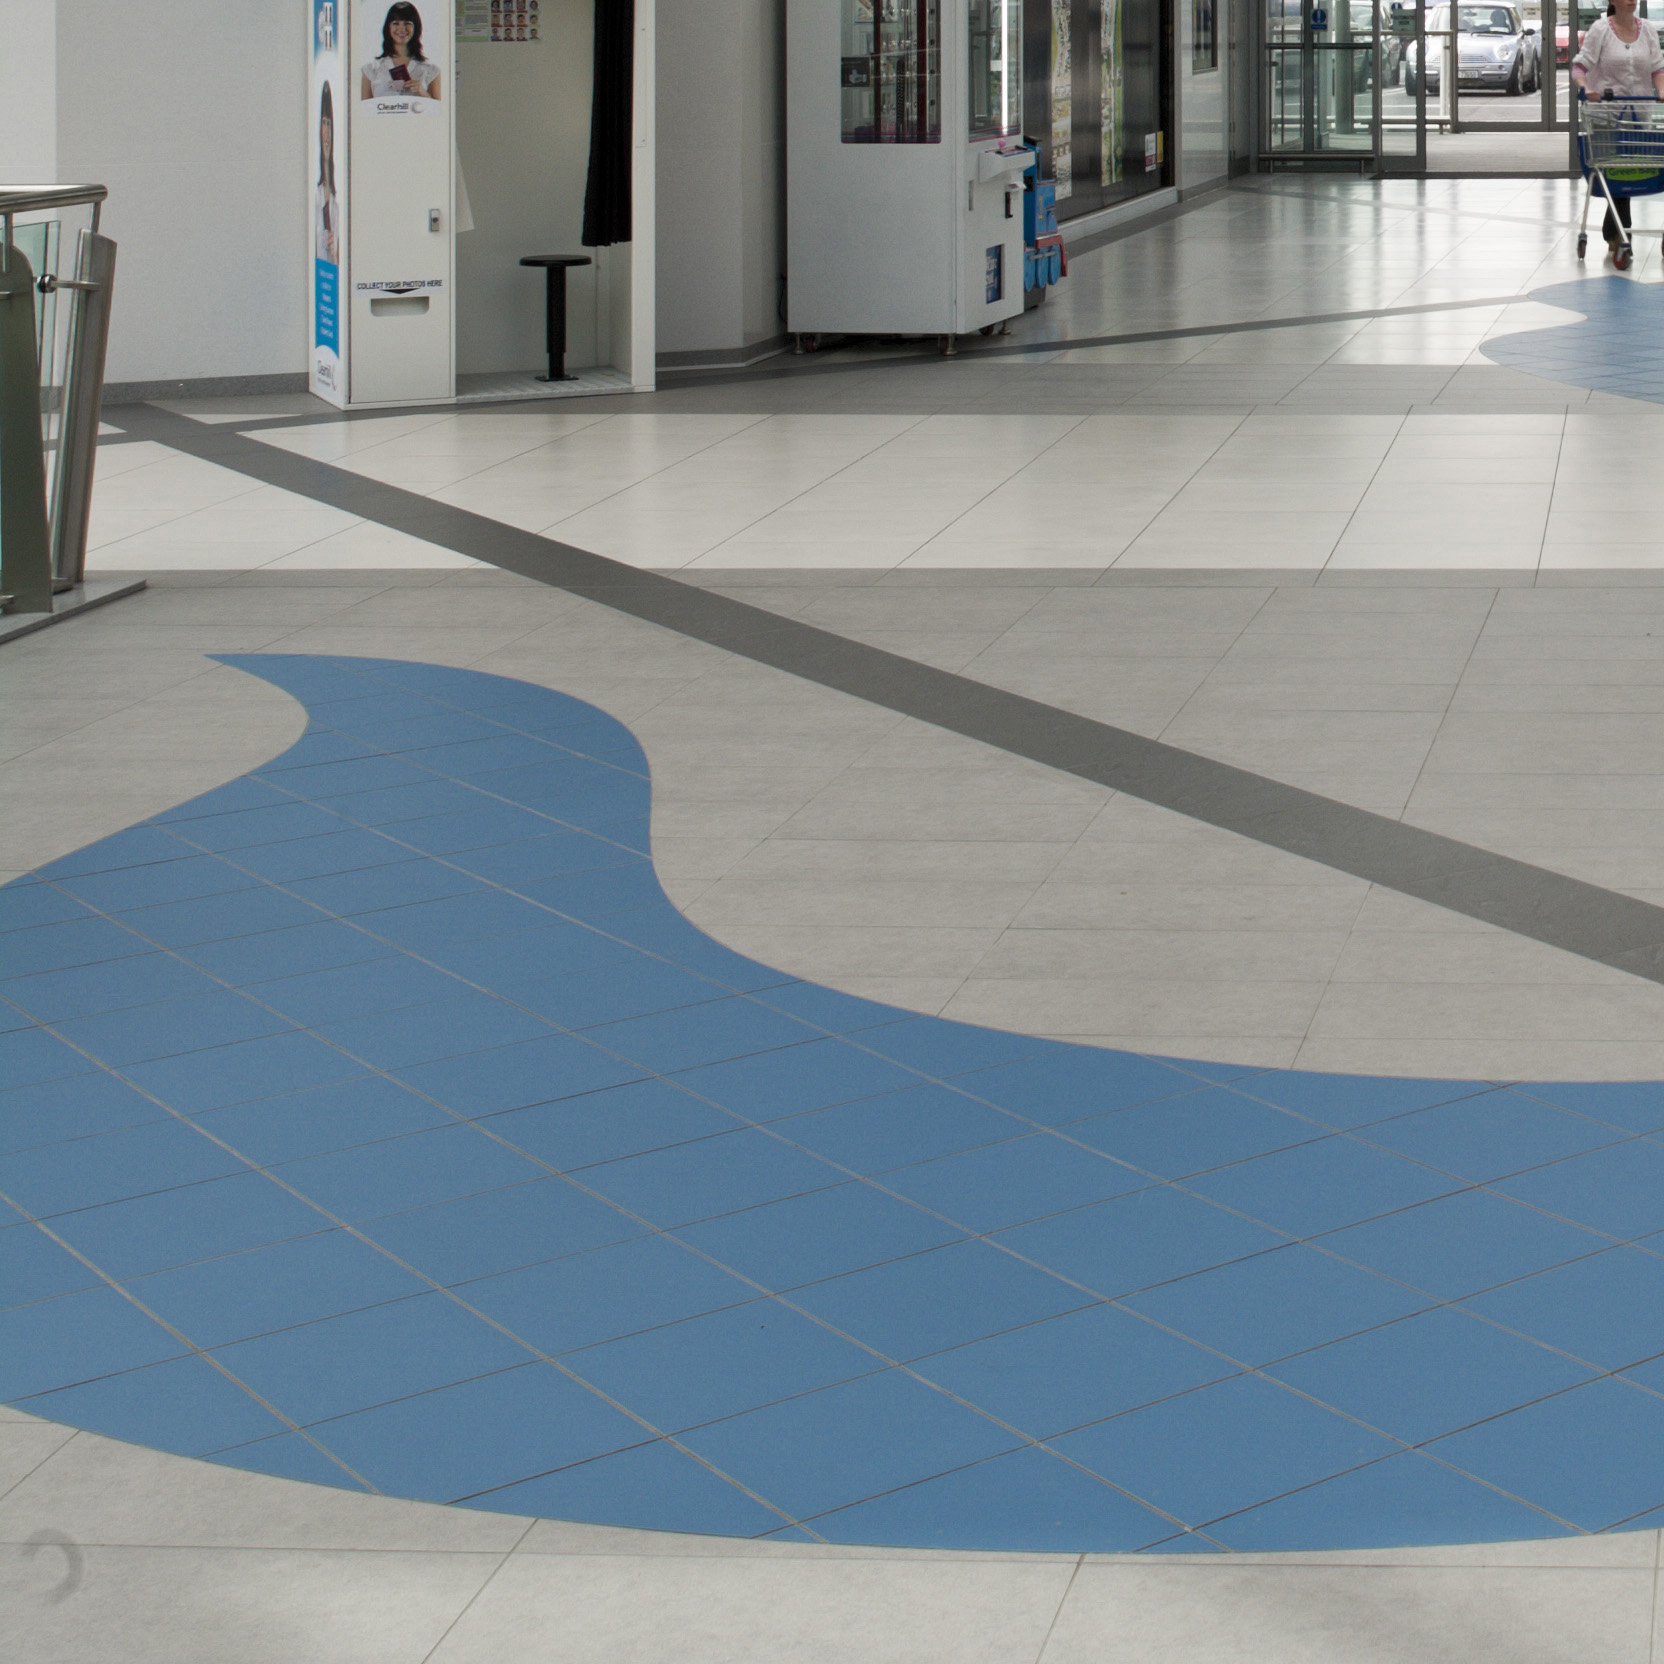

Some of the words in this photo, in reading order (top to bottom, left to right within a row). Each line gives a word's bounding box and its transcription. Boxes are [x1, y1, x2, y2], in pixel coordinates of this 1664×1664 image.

[1609, 167, 1637, 177] Green
[356, 282, 384, 290] COLLECT
[427, 279, 443, 287] HERE
